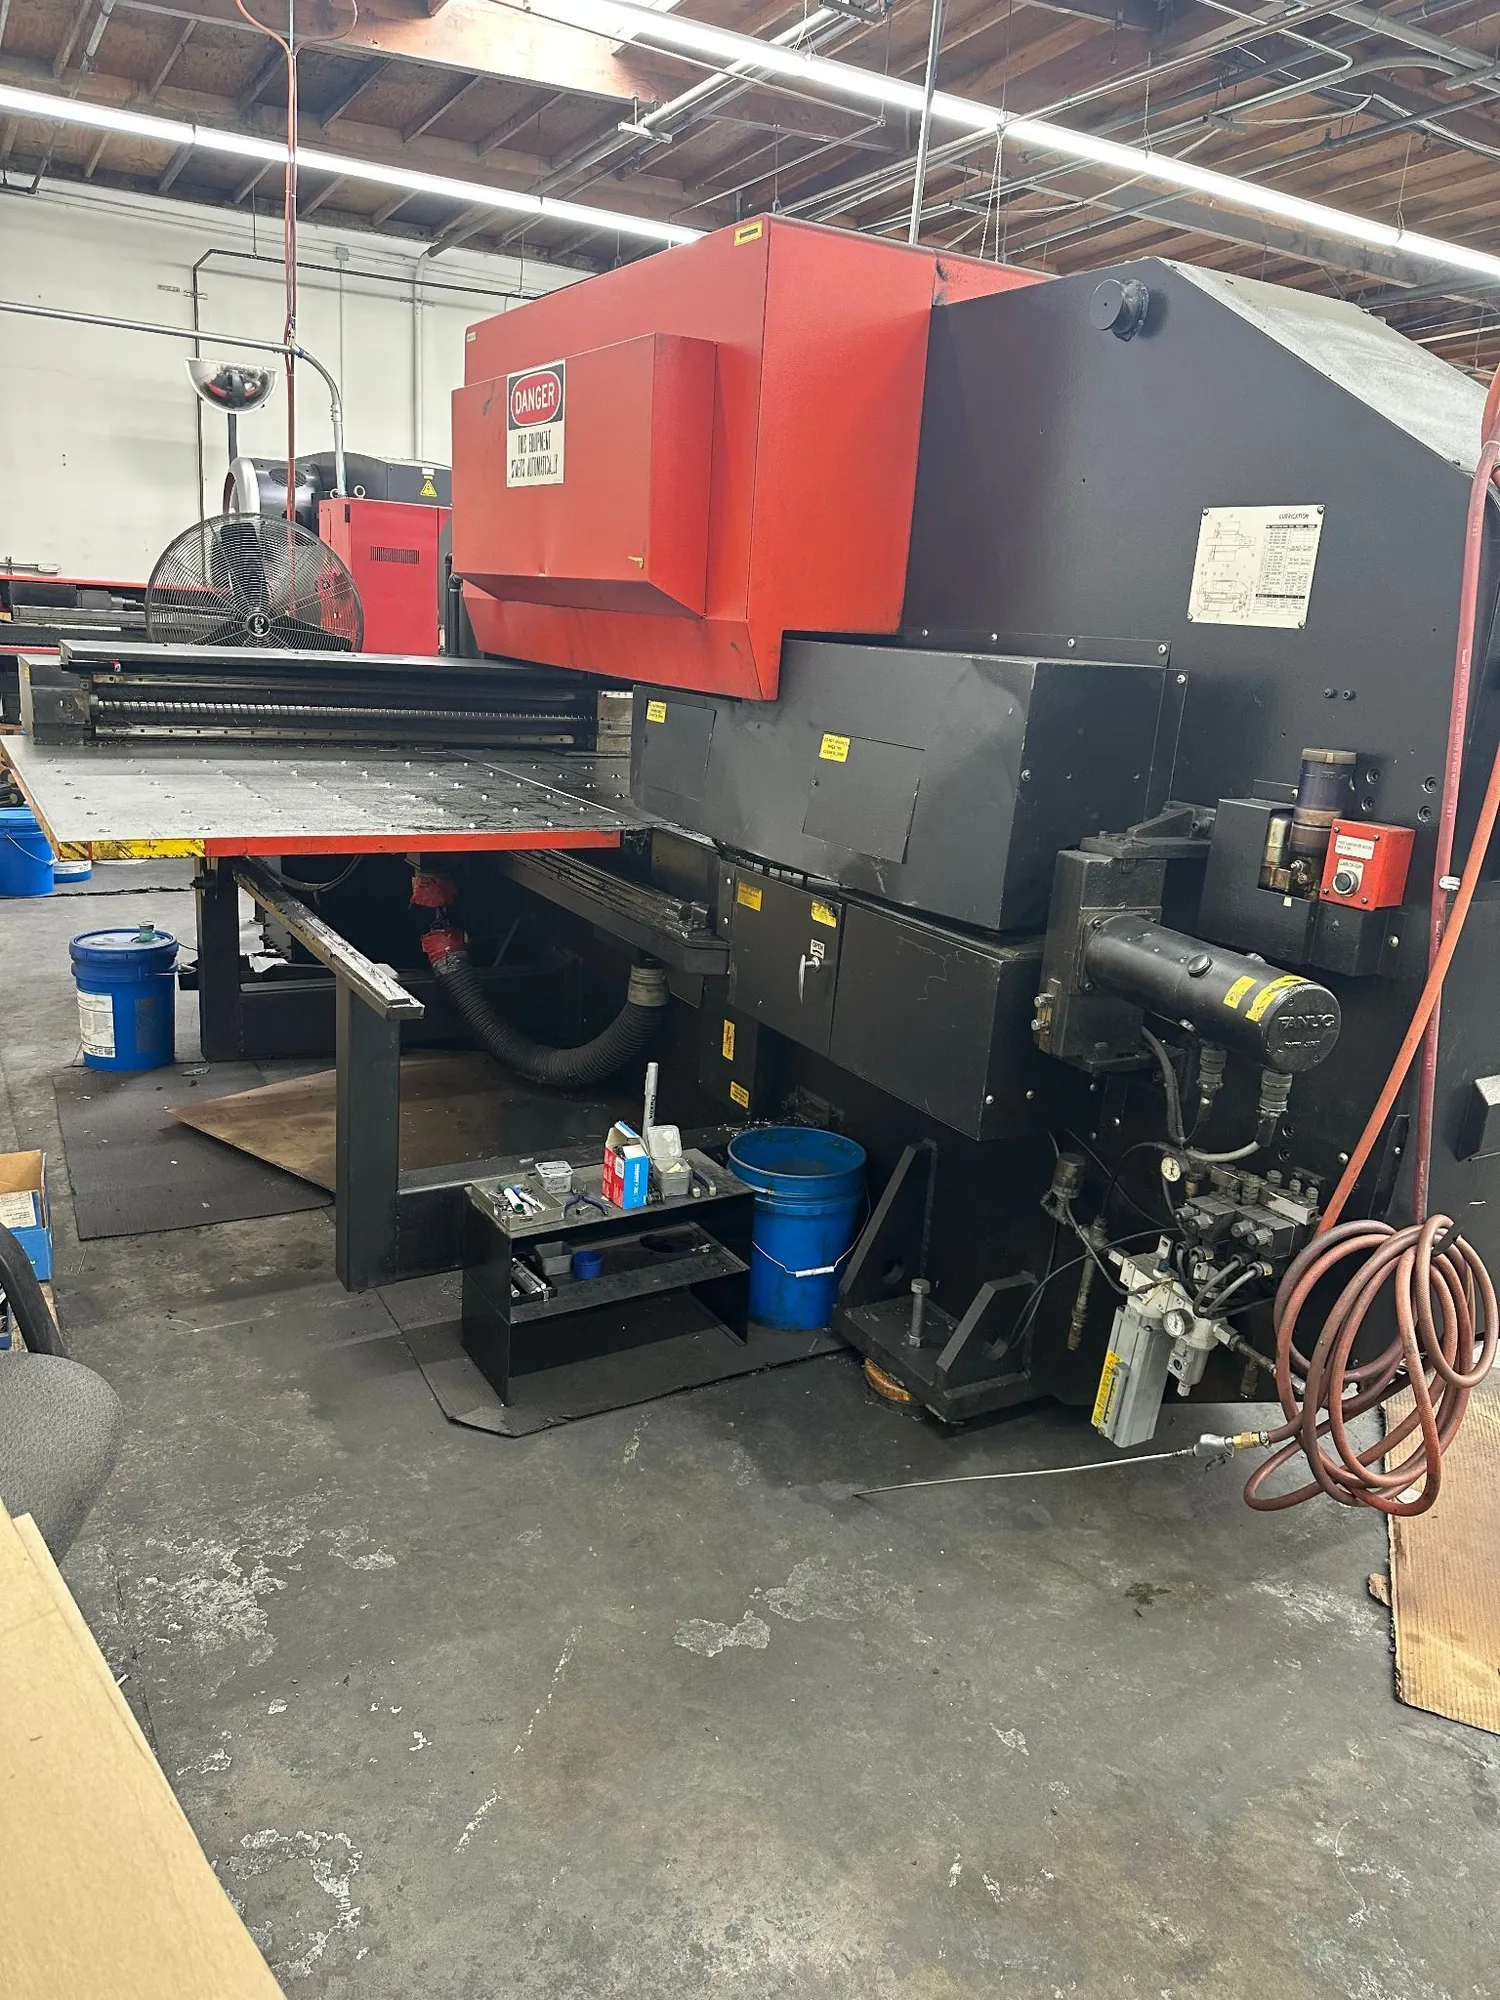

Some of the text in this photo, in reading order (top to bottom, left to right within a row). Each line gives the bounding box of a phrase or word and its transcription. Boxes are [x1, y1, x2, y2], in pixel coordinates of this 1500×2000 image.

[515, 382, 555, 415] DANGER
[517, 430, 551, 454] THIS EQUIPMENT
[812, 941, 823, 950] OPEN
